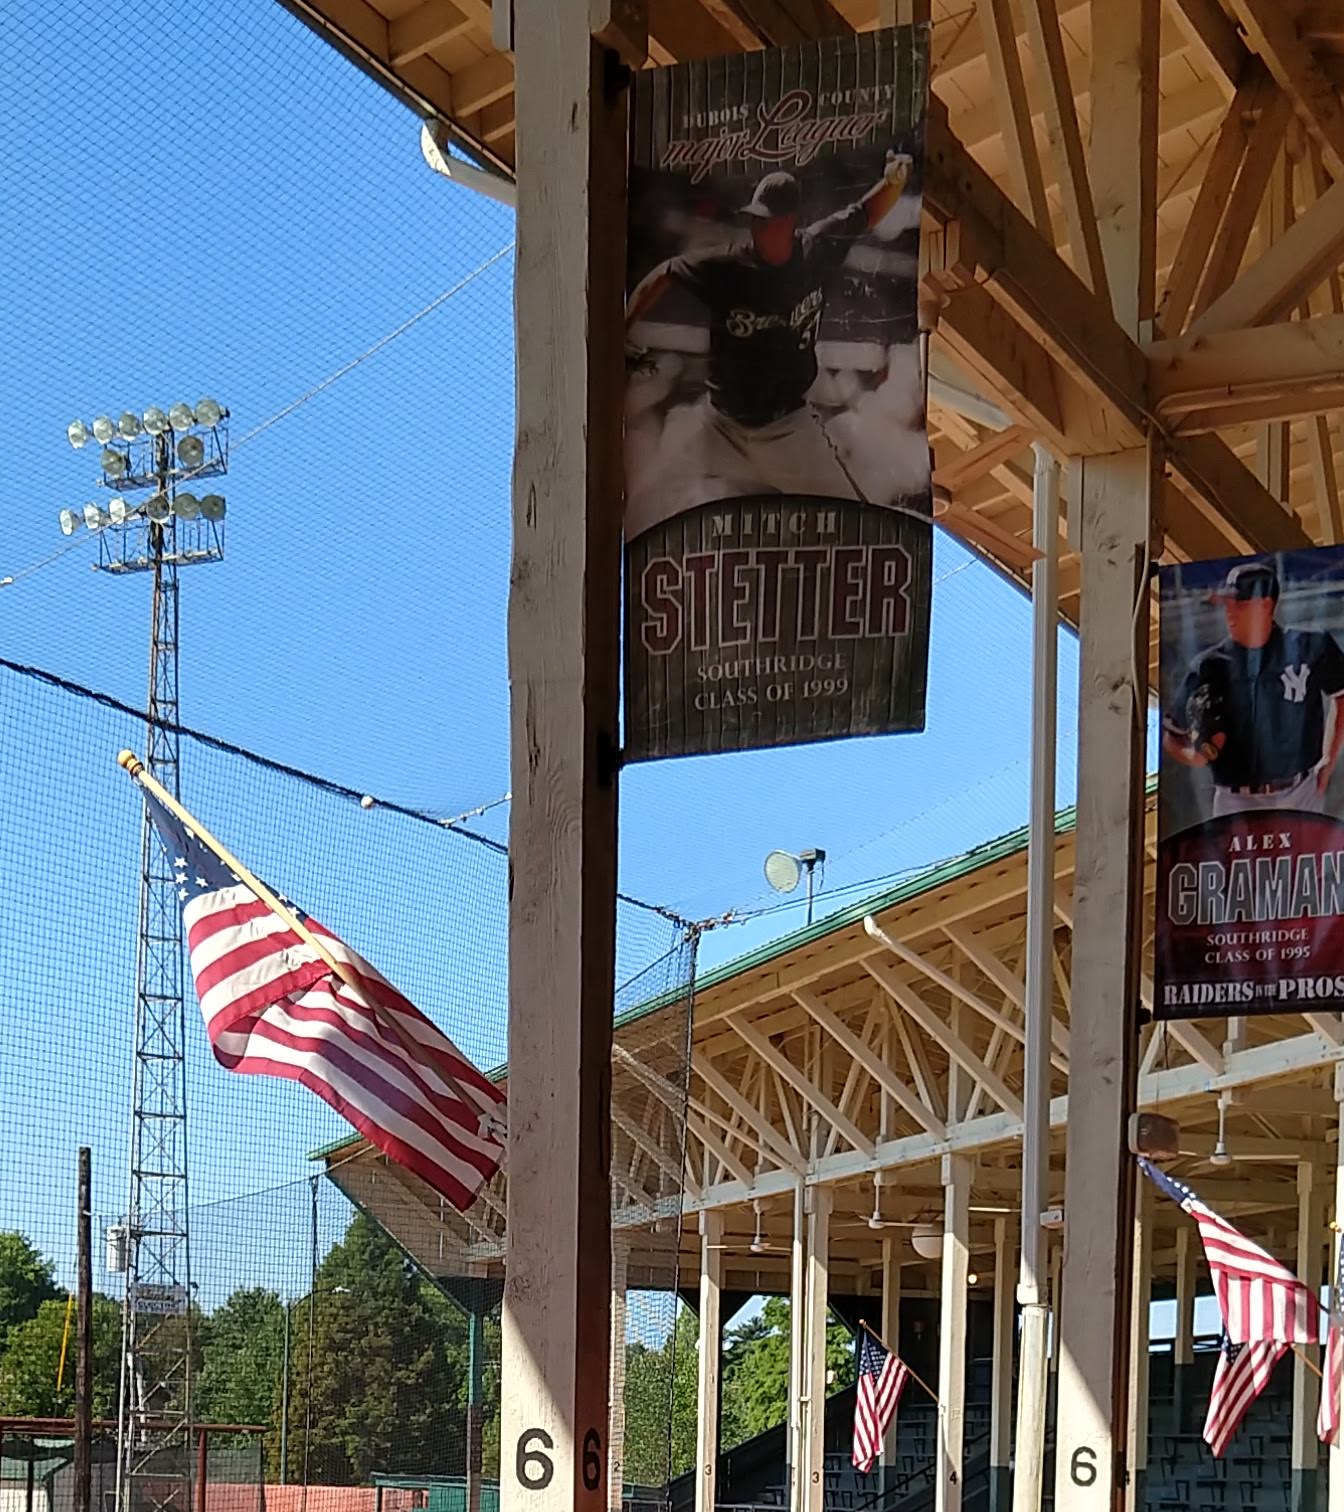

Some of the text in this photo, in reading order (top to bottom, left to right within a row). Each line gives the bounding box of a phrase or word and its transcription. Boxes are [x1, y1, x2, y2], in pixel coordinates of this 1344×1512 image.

[819, 84, 893, 105] COUNTY
[712, 512, 837, 537] MITCH
[641, 544, 913, 655] STETTER
[697, 653, 847, 683] SOUTHRIDGE
[694, 677, 849, 711] CLASS OF 1999
[1228, 832, 1292, 852] ALEX
[1206, 928, 1310, 946] SOUTHRIDGE
[1204, 946, 1311, 964] CLASS OF 1995
[1163, 980, 1255, 1006] RAIDERS
[516, 1428, 554, 1490] 6
[582, 1427, 601, 1490] 6
[704, 1464, 712, 1476] 3
[1070, 1446, 1097, 1487] 6
[811, 1471, 820, 1484] 3
[949, 1470, 958, 1485] 4
